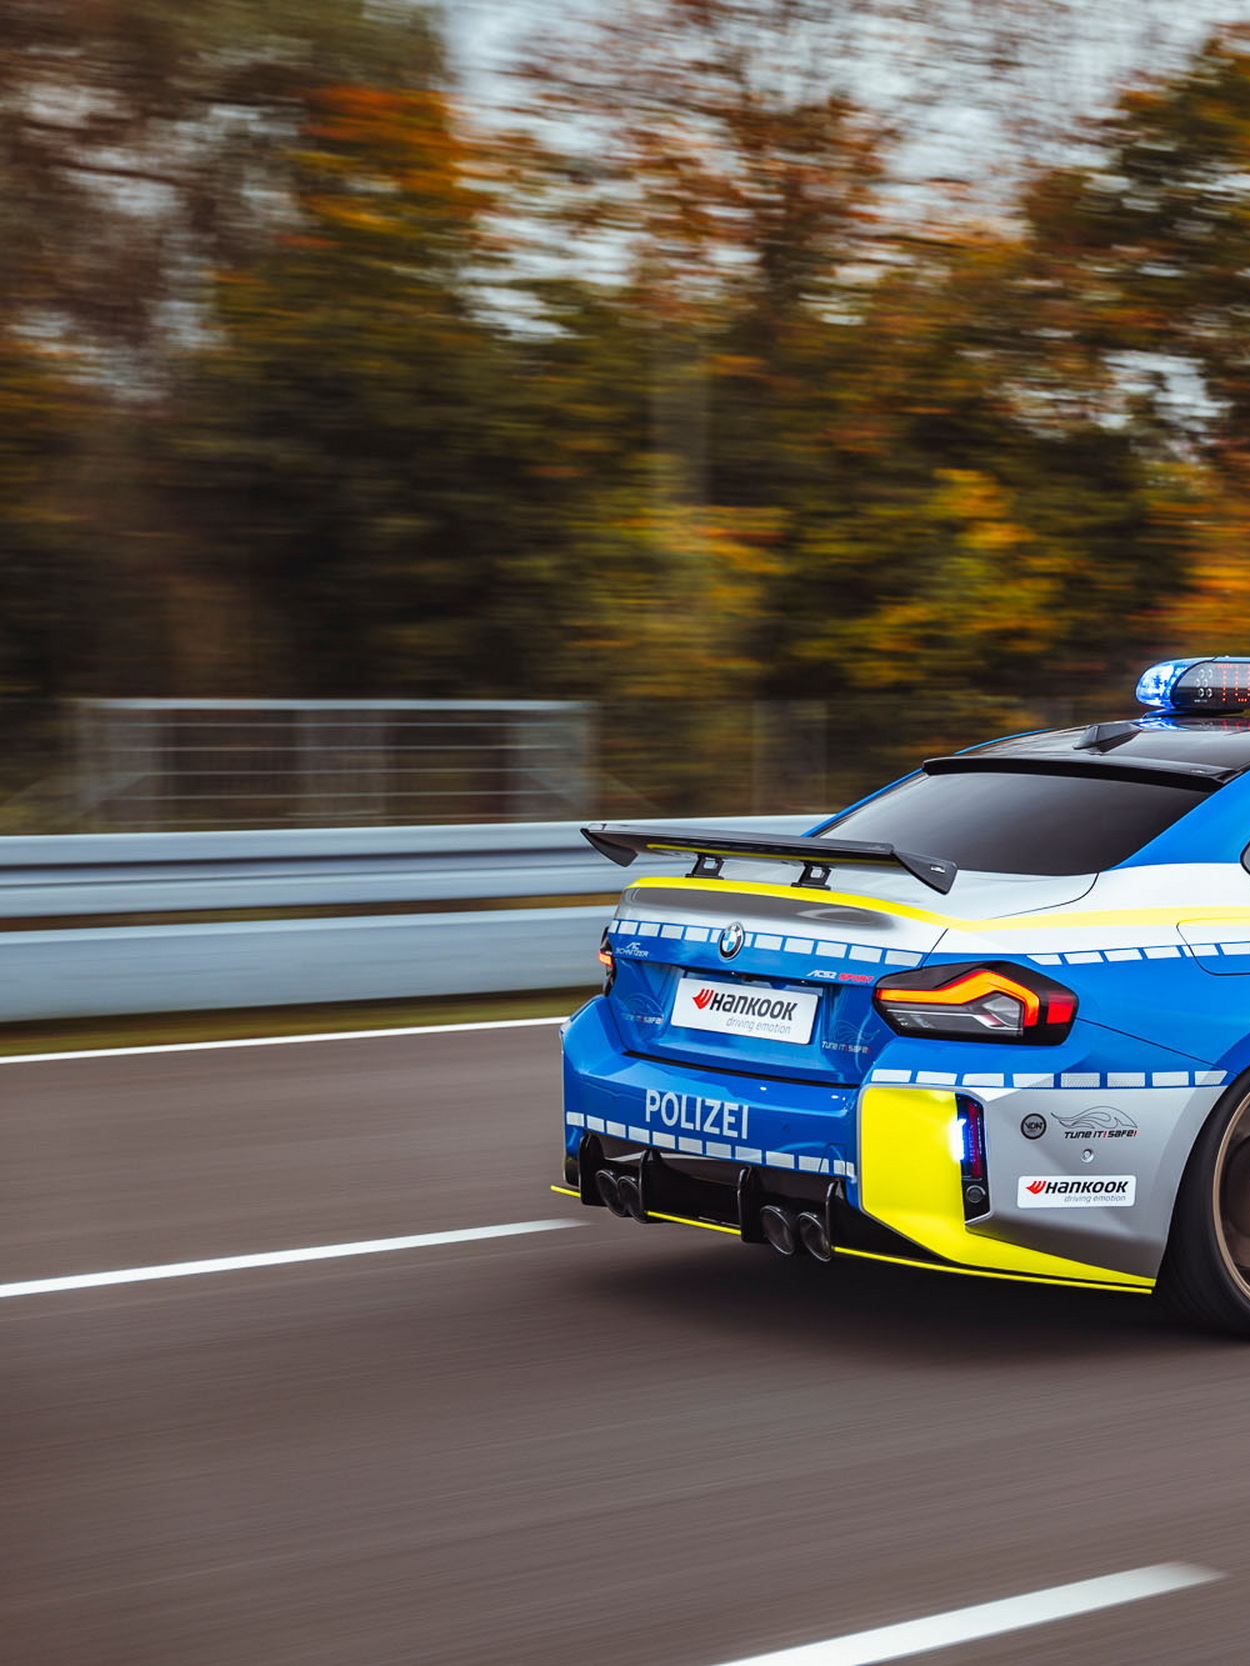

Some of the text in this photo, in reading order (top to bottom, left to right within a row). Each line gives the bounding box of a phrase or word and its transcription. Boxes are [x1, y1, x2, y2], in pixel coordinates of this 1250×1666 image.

[838, 973, 875, 984] SPORT
[726, 1016, 792, 1035] driving emotion
[646, 1089, 749, 1140] POLIZEI
[1064, 1194, 1126, 1203] driving emotion
